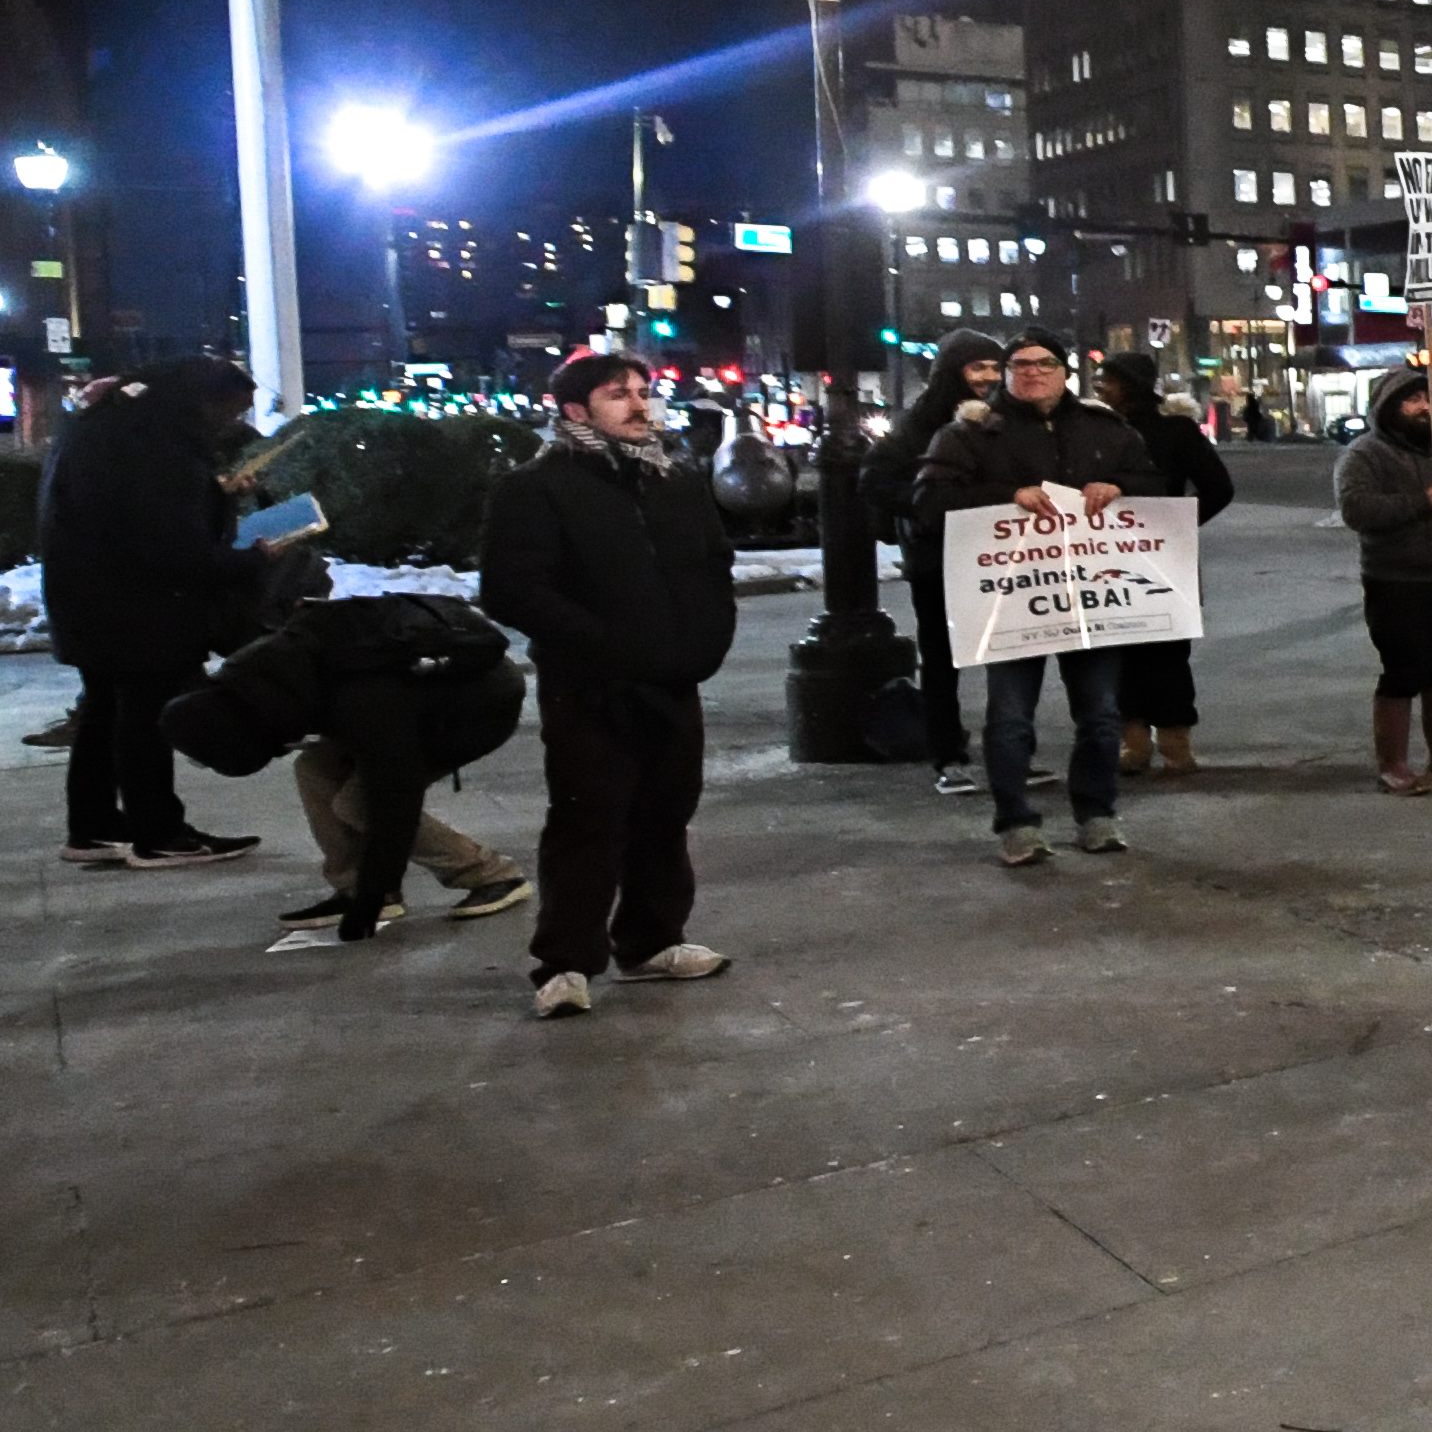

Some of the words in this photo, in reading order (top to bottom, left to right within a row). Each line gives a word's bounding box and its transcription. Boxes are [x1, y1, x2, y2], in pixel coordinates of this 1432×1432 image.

[993, 513, 1077, 540] STOP
[1087, 510, 1145, 531] U.S.
[977, 538, 1108, 567] economic
[1114, 538, 1165, 554] war
[979, 564, 1088, 596] against
[1028, 588, 1132, 615] CUBA!
